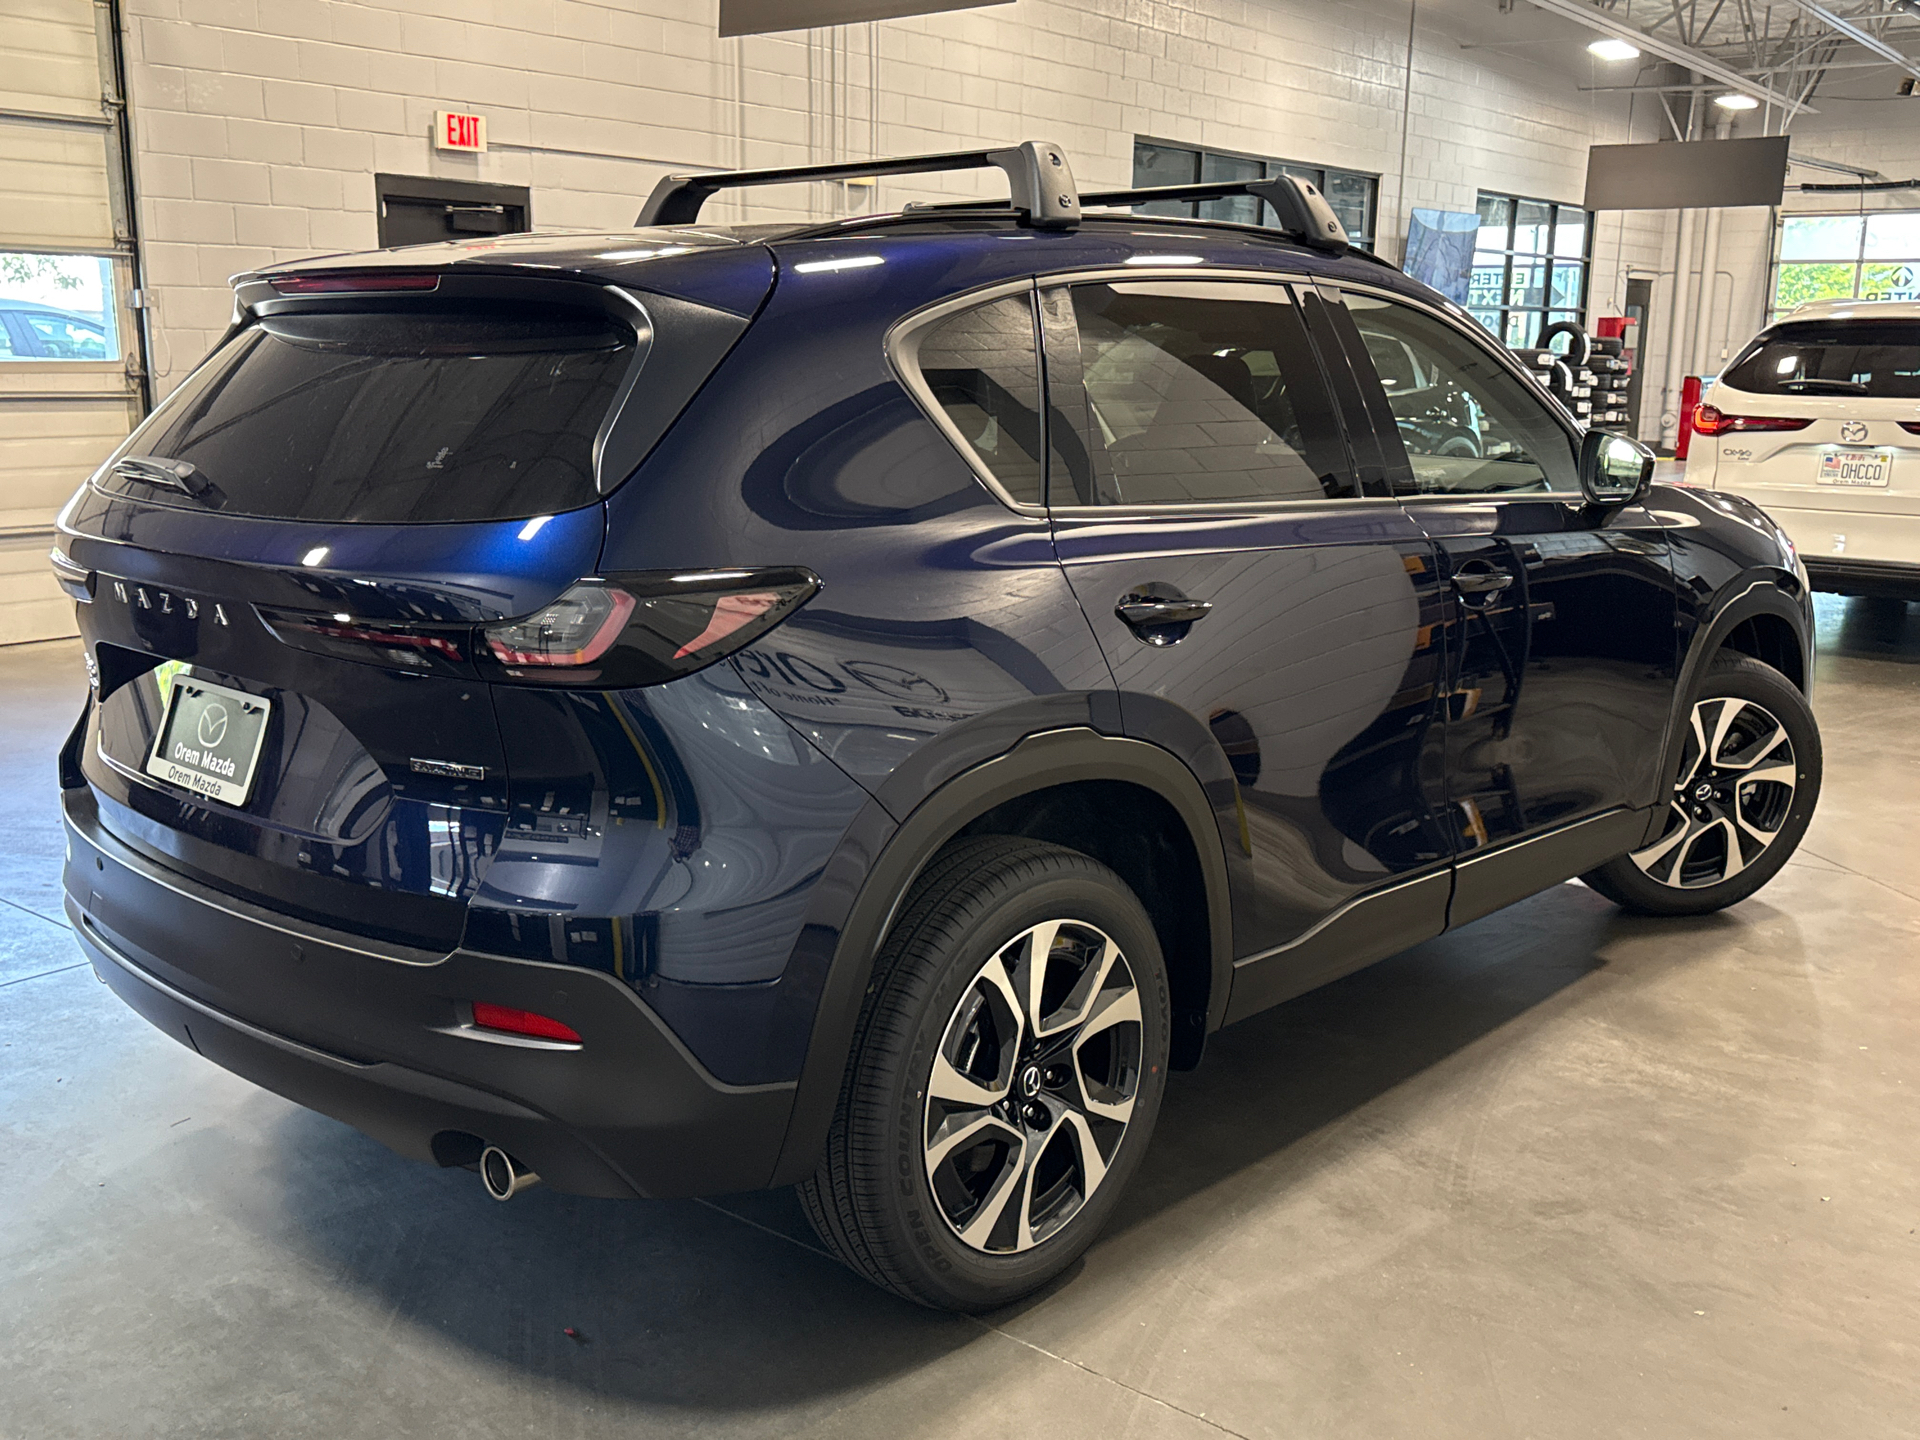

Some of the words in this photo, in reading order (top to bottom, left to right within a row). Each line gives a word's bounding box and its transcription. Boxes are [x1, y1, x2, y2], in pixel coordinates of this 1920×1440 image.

[447, 113, 479, 148] EXIT
[113, 581, 229, 626] MAZDA
[174, 741, 200, 766] Orem
[201, 751, 236, 777] Mazda
[168, 765, 191, 785] Orem
[192, 774, 222, 796] Mazda
